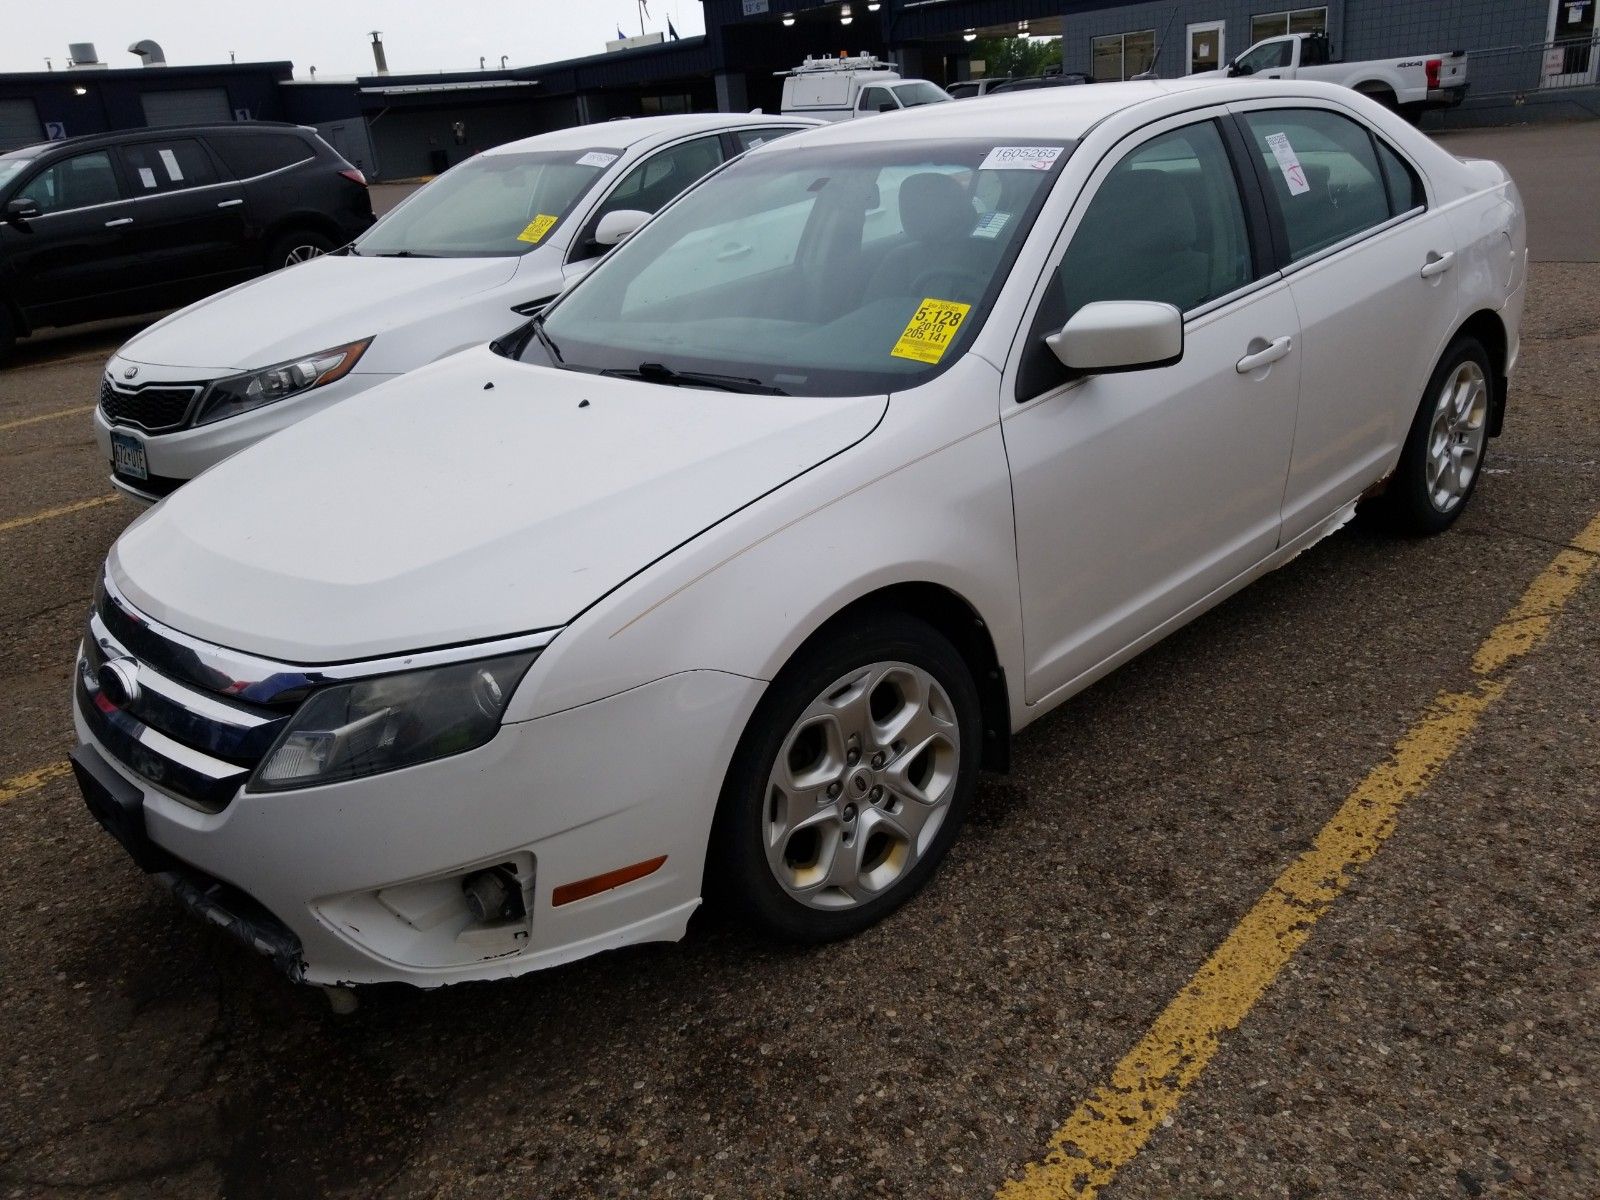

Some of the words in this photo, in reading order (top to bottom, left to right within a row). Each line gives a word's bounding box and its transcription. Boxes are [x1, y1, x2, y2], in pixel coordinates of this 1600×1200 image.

[49, 123, 63, 139] 2
[995, 148, 1058, 158] 1605265
[915, 307, 962, 326] 5:128
[918, 322, 944, 333] 2010
